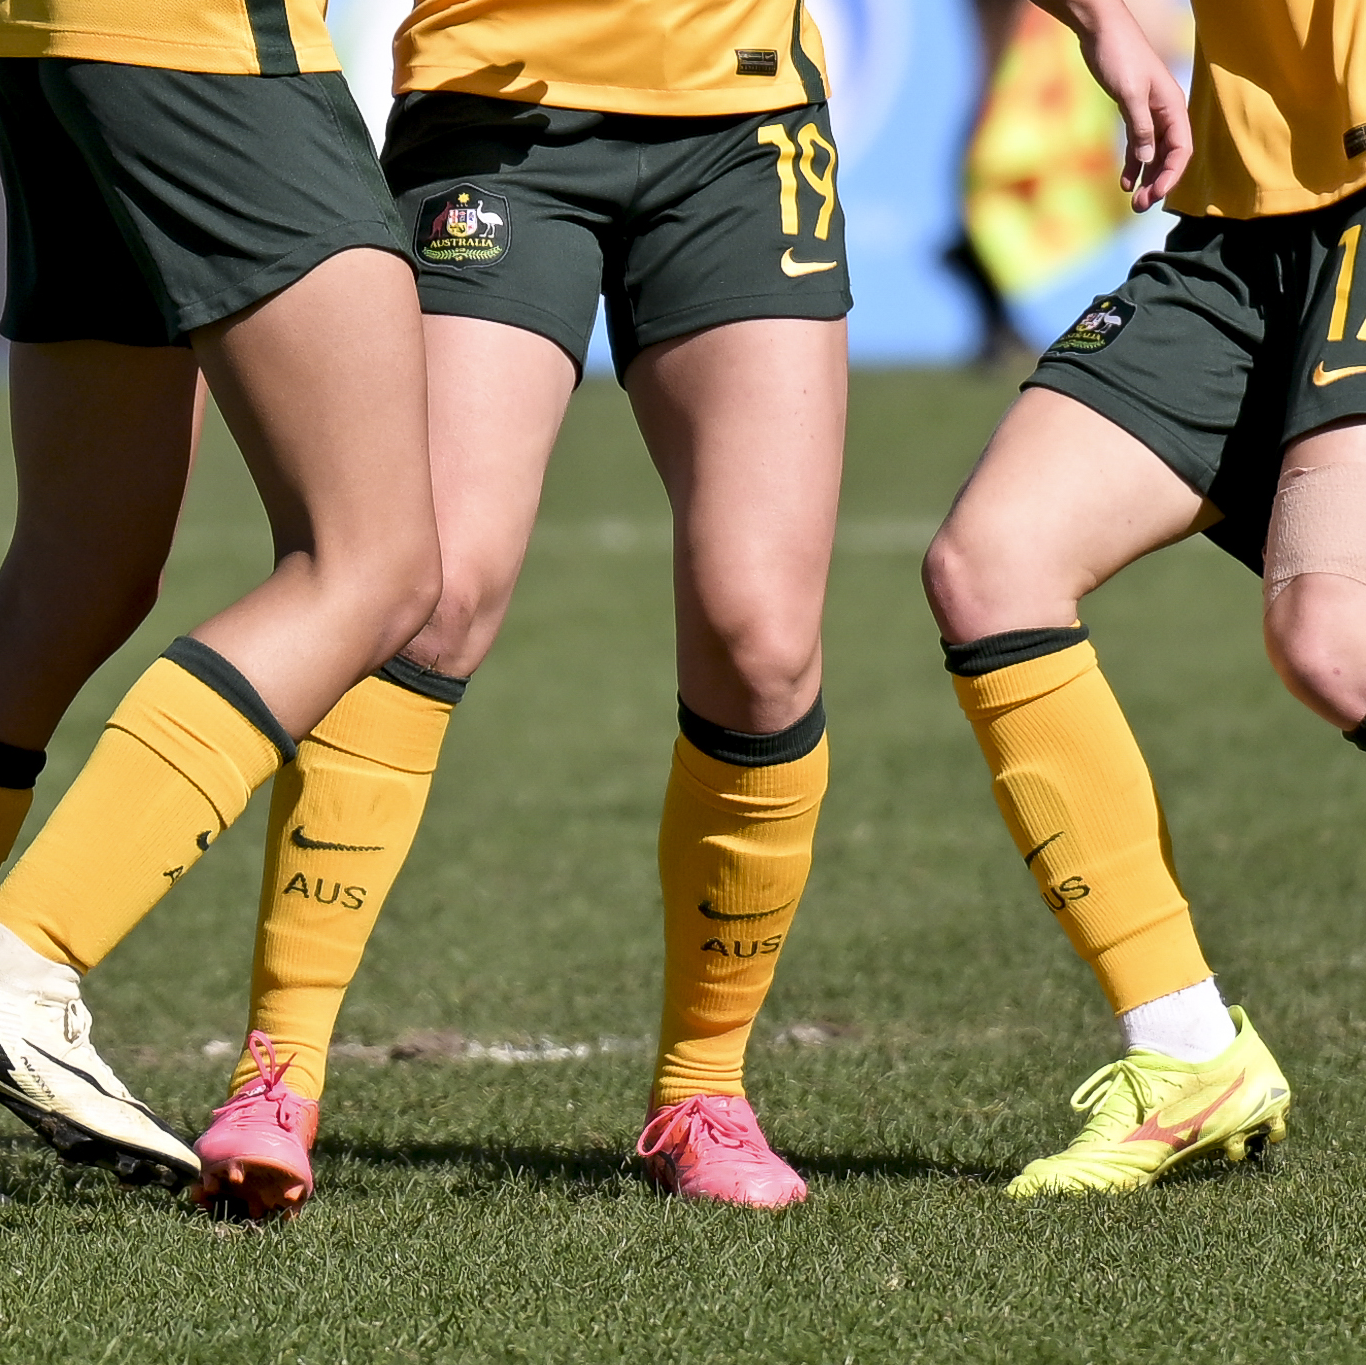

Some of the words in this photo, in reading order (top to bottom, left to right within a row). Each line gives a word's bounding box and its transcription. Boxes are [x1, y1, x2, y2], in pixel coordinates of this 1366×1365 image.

[757, 122, 836, 241] 19
[430, 237, 494, 248] AUSTRALIA
[281, 872, 367, 910] AUS
[1041, 875, 1091, 912] US
[700, 934, 782, 958] AUS
